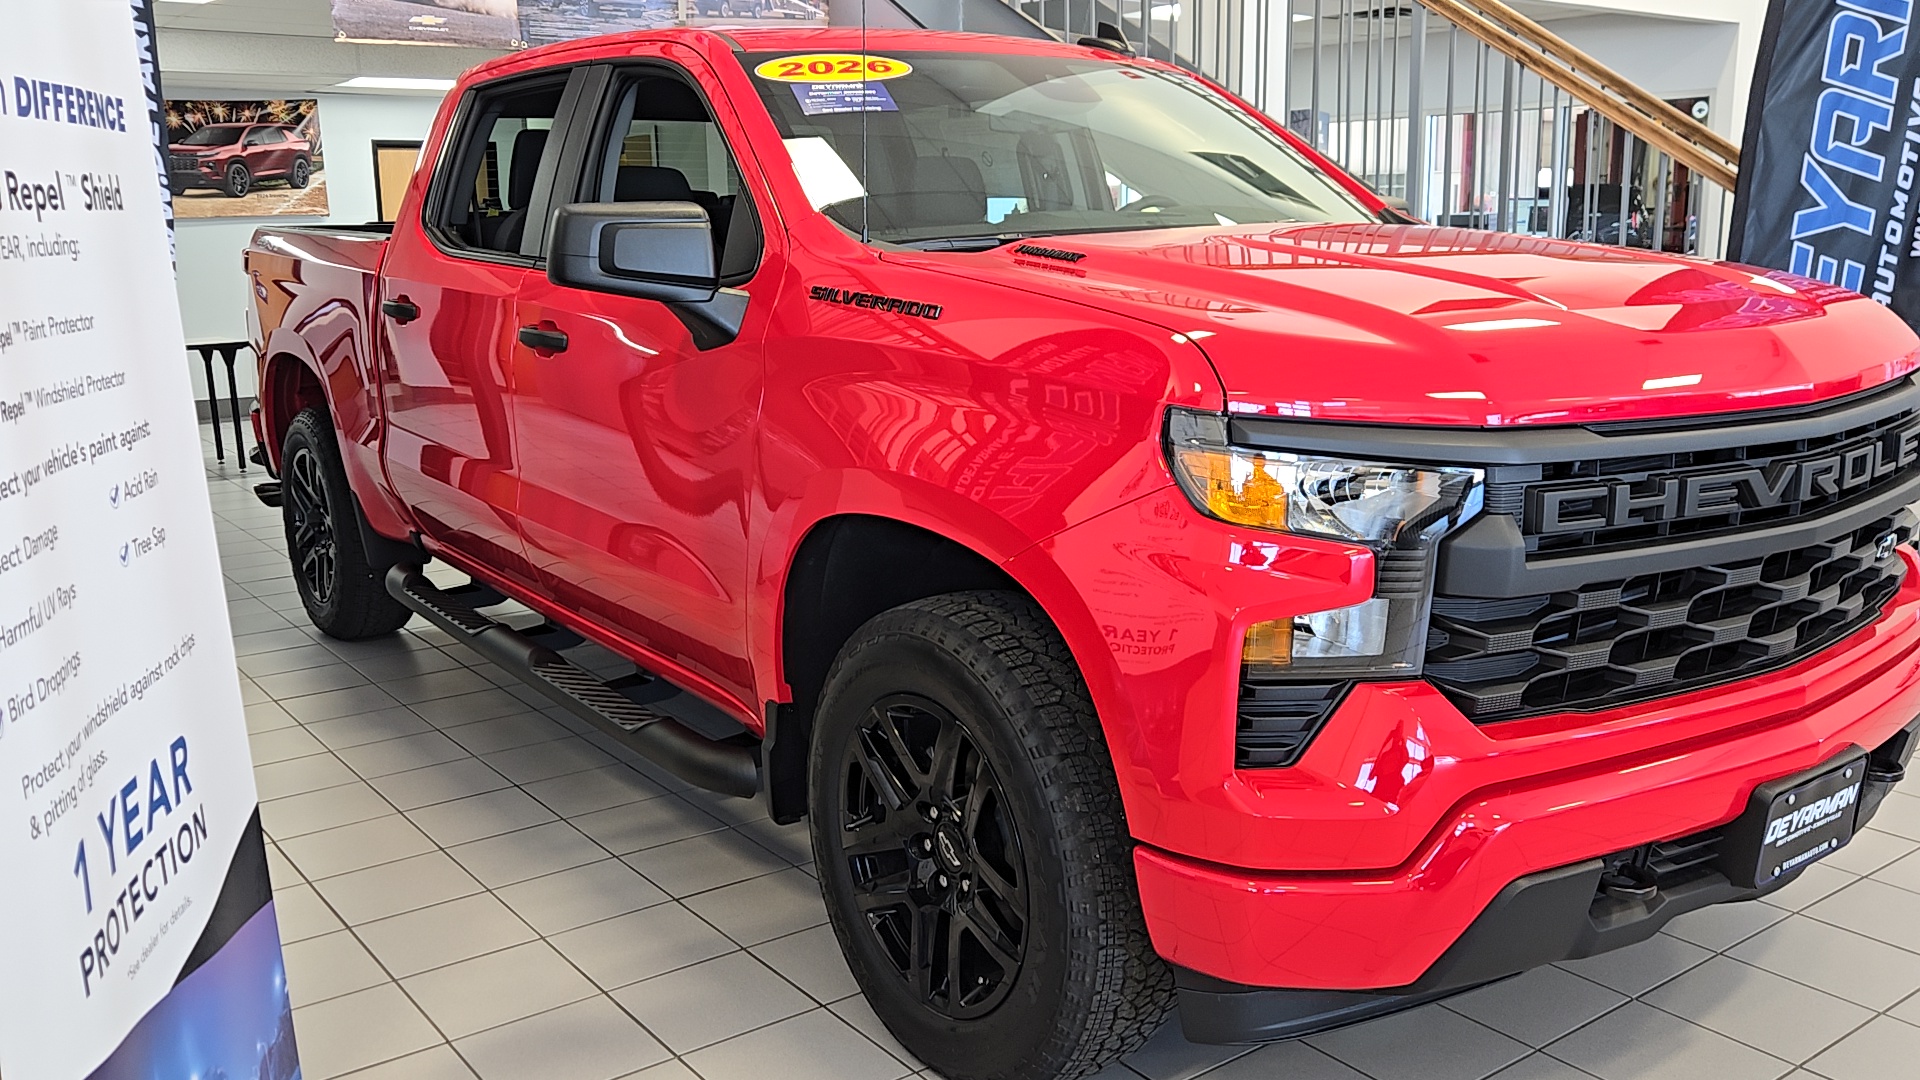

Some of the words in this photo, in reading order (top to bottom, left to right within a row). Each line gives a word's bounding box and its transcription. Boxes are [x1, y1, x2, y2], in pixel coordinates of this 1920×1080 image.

[778, 60, 893, 77] 2026
[14, 76, 126, 132] DIFFERENCE
[81, 172, 124, 211] Shield
[0, 235, 25, 262] EAR,
[25, 232, 81, 261] including:
[809, 286, 943, 320] SILVERADO
[22, 319, 47, 341] Paint
[48, 314, 95, 337] Protector
[33, 376, 85, 409] Windshield
[86, 370, 125, 395] Protector
[0, 472, 21, 500] ect
[21, 465, 41, 497] your
[42, 441, 87, 477] vehicle's
[89, 432, 119, 465] paint
[119, 419, 151, 451] against
[124, 473, 143, 501] Acid
[143, 468, 159, 490] Rain
[0, 544, 22, 574] ect
[23, 525, 58, 560] Damage
[132, 538, 153, 558] Tree
[152, 526, 166, 551] Sap
[43, 590, 56, 621] UV
[56, 584, 76, 610] Rays
[7, 684, 35, 723] Bird
[36, 651, 81, 702] Droppings
[21, 749, 65, 800] Protect
[64, 732, 82, 770] your
[82, 683, 129, 742] windshield
[129, 661, 164, 701] against
[164, 644, 181, 674] rock
[181, 633, 196, 658] chips
[30, 815, 42, 840] &
[44, 785, 77, 837] pitting
[77, 764, 86, 793] of
[1763, 781, 1861, 846] DEYARMAN
[73, 837, 93, 916] 1
[97, 735, 193, 877] YEAR
[79, 803, 208, 999] PROTECTION
